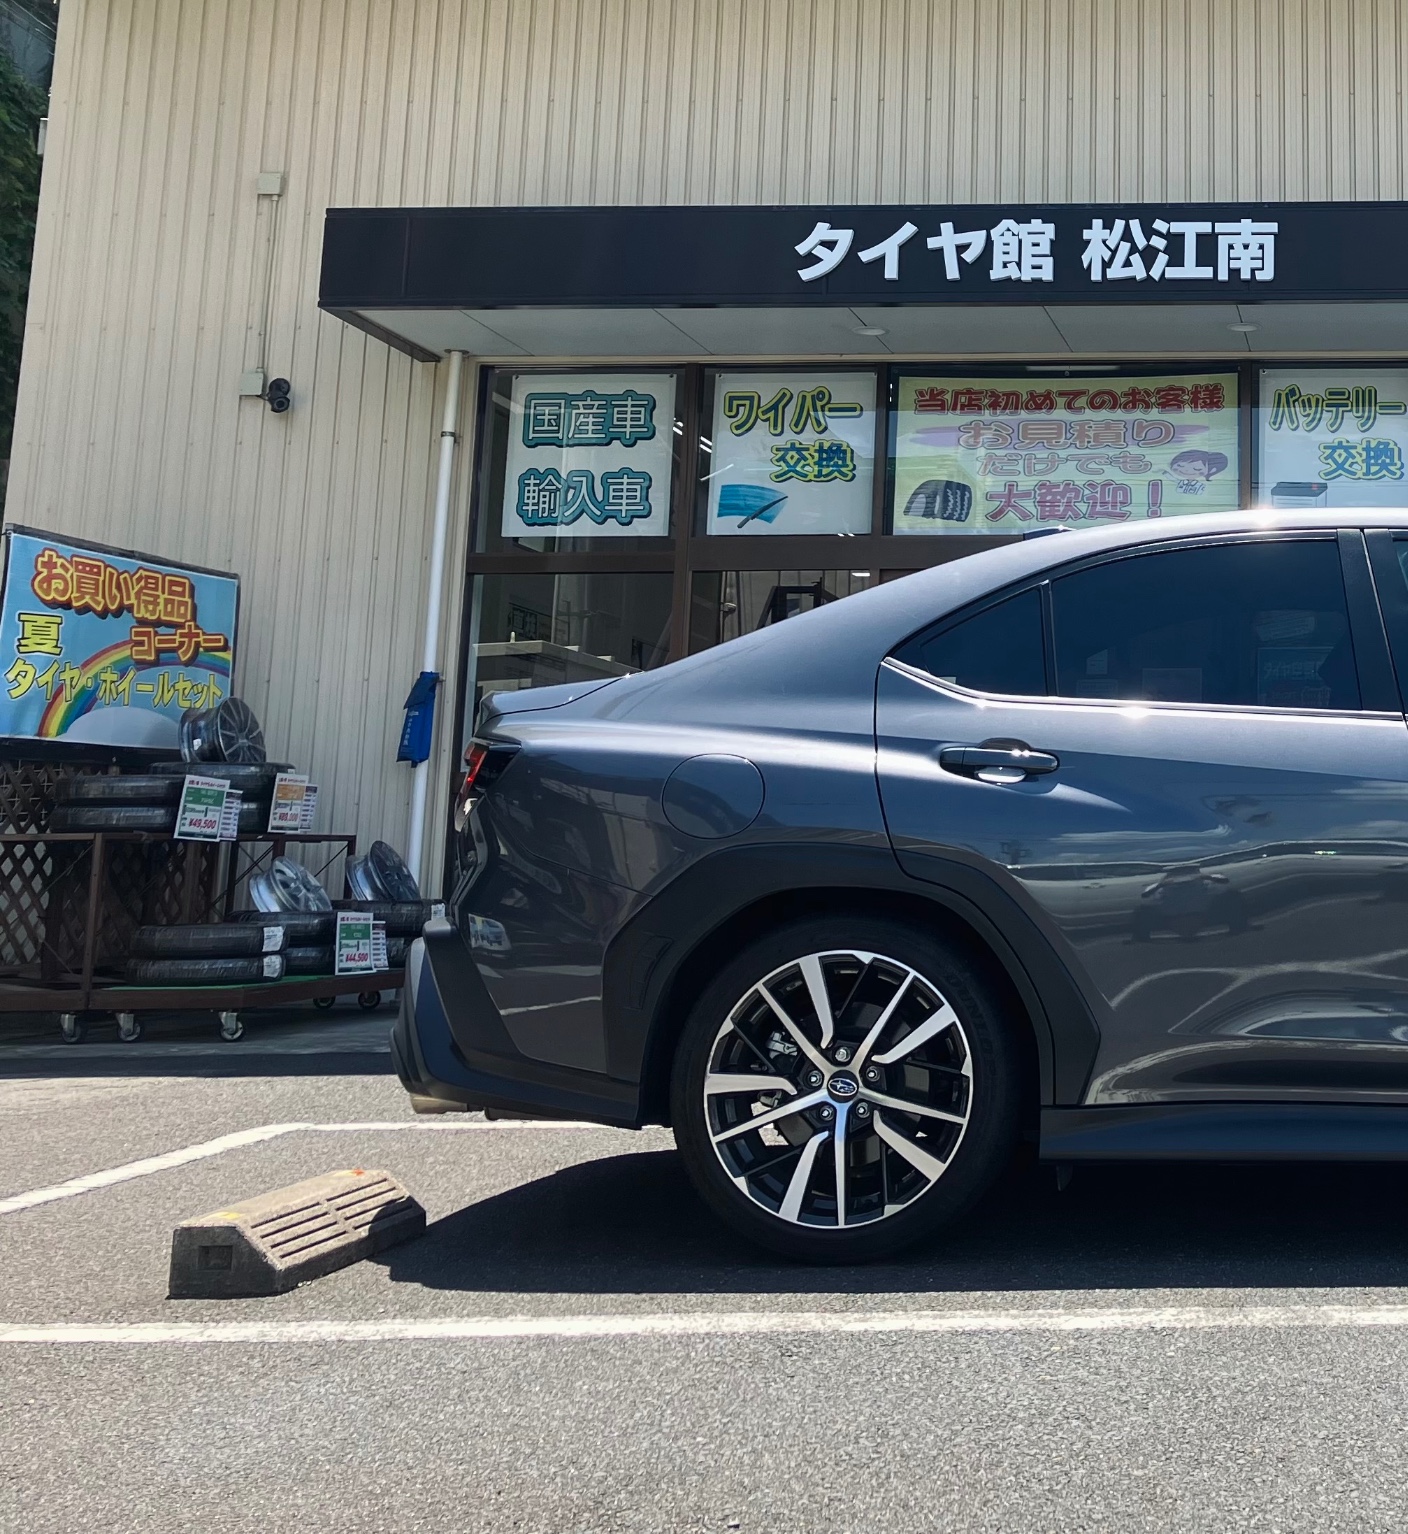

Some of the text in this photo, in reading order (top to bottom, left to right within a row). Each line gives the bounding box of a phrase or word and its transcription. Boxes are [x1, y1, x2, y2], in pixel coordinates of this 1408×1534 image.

[794, 218, 1279, 283] タイヤ館 松江南
[525, 392, 653, 444] 国産車
[725, 387, 862, 435] ワイパー
[914, 383, 1225, 416] 当店初めてのお客様
[958, 420, 1176, 450] お見積り
[770, 440, 855, 483] 交換
[977, 452, 1152, 477] だけでも
[1318, 438, 1404, 480] 交換
[519, 469, 650, 523] 輸入車
[33, 548, 195, 625] お買い得品
[17, 612, 63, 656] 夏
[130, 621, 228, 666] コーナー
[4, 657, 223, 709] タイヤ・ホイールセット
